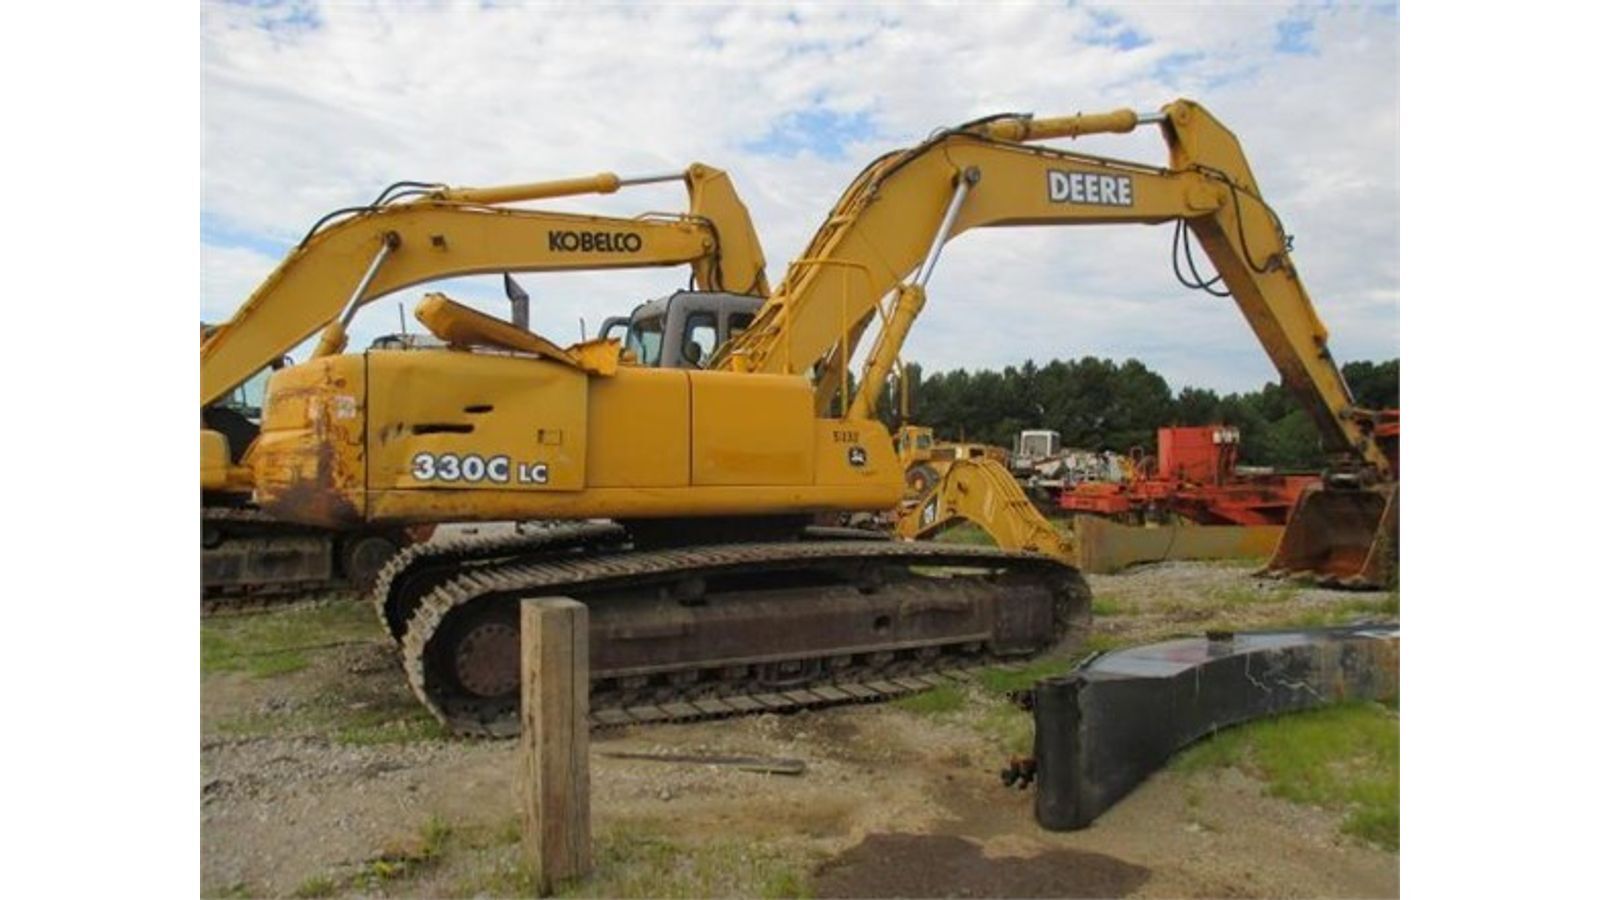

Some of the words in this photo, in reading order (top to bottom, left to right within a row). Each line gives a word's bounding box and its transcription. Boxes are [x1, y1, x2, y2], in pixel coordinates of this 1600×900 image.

[1048, 170, 1133, 207] DEERE
[548, 230, 642, 253] KOBELCO
[412, 453, 510, 483] 330C
[518, 463, 548, 484] LC
